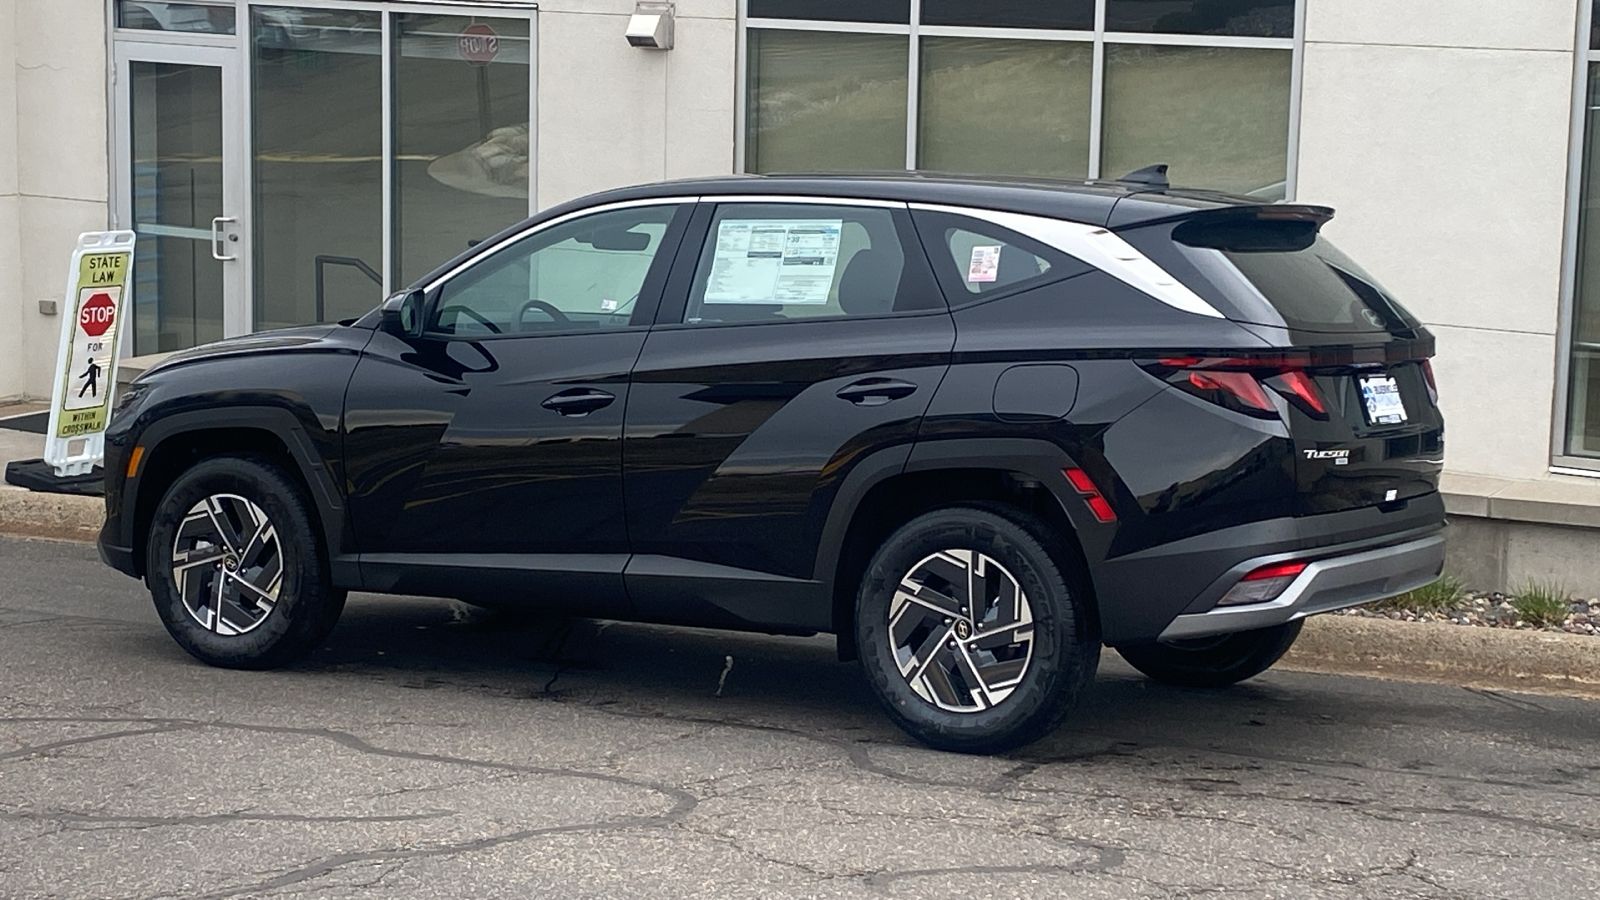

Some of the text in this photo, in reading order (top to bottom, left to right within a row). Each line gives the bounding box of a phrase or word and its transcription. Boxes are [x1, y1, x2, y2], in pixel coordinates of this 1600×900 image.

[89, 256, 121, 269] STATE
[92, 271, 115, 283] LAW
[81, 306, 115, 324] STOP
[87, 343, 104, 352] FOR
[72, 411, 97, 422] WITHIN
[62, 421, 102, 434] CROSSWALK
